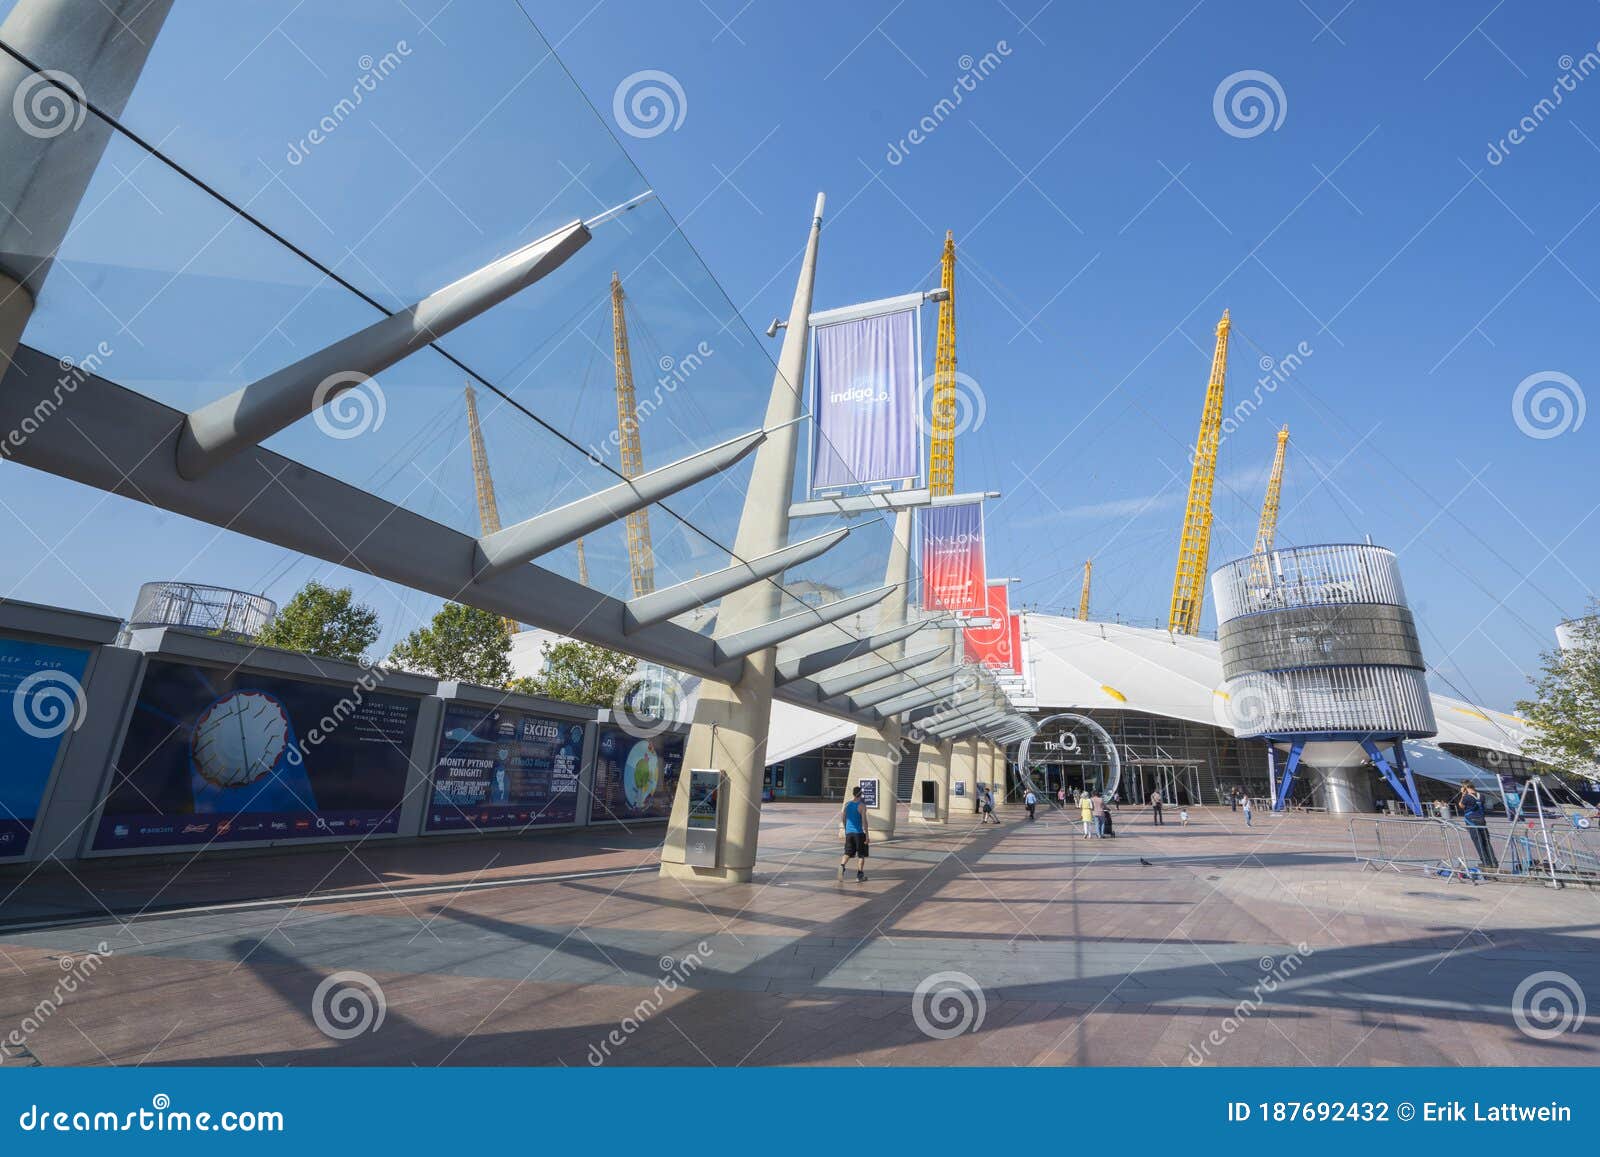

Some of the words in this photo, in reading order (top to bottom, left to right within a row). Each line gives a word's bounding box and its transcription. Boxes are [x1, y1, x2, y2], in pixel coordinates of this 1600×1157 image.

[831, 387, 873, 403] indigo
[523, 723, 558, 738] EXCITED
[439, 757, 466, 767] MONTY
[467, 759, 494, 768] PYTHON
[450, 768, 482, 777] TONIGHT!
